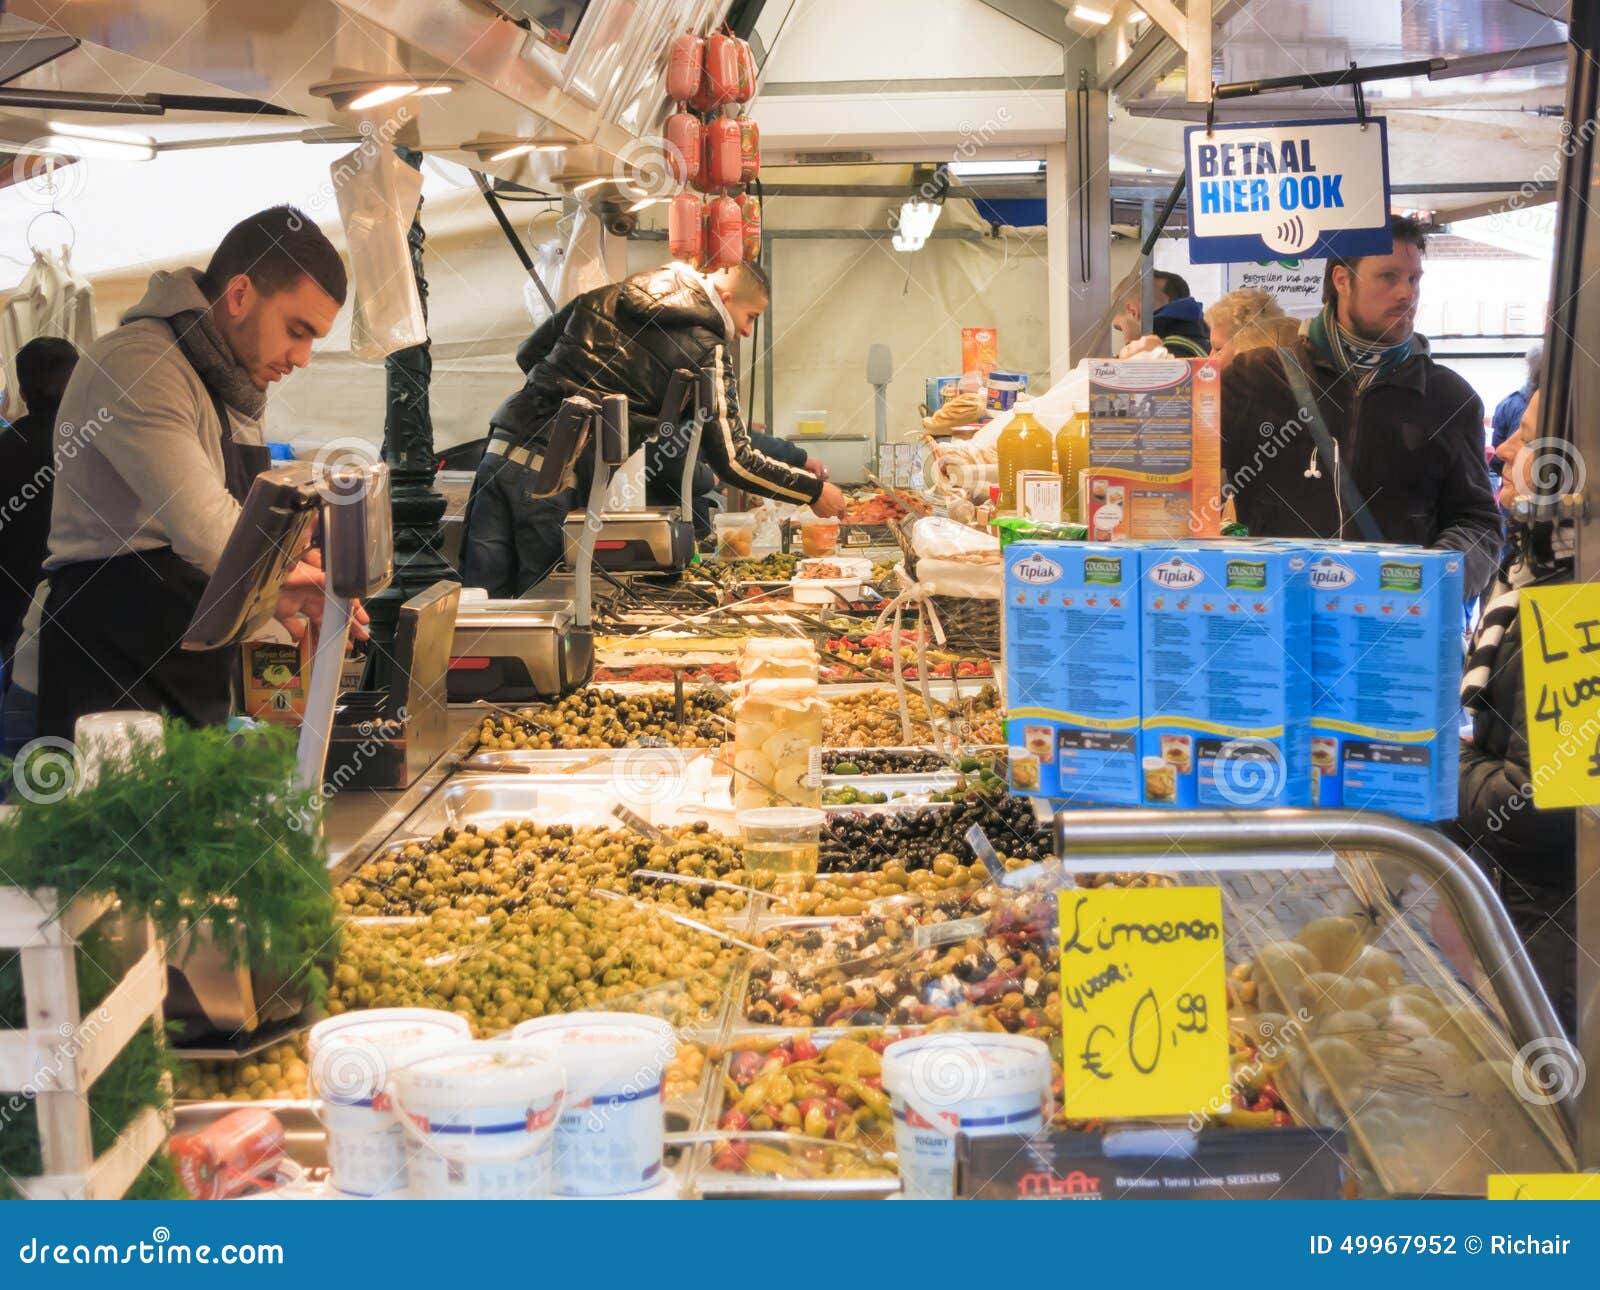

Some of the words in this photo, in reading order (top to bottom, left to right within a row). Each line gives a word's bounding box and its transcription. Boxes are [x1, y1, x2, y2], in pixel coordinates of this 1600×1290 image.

[1198, 139, 1317, 177] BETAAL
[1200, 178, 1271, 214] HIER
[1279, 174, 1345, 211] OOK
[1095, 368, 1117, 377] Tipiak
[1019, 564, 1055, 580] Tipiak
[1157, 568, 1196, 585] Tipiak
[1064, 897, 1220, 954] Limoenen
[1080, 1024, 1116, 1080] €
[1226, 1172, 1282, 1186] SEEDLESS
